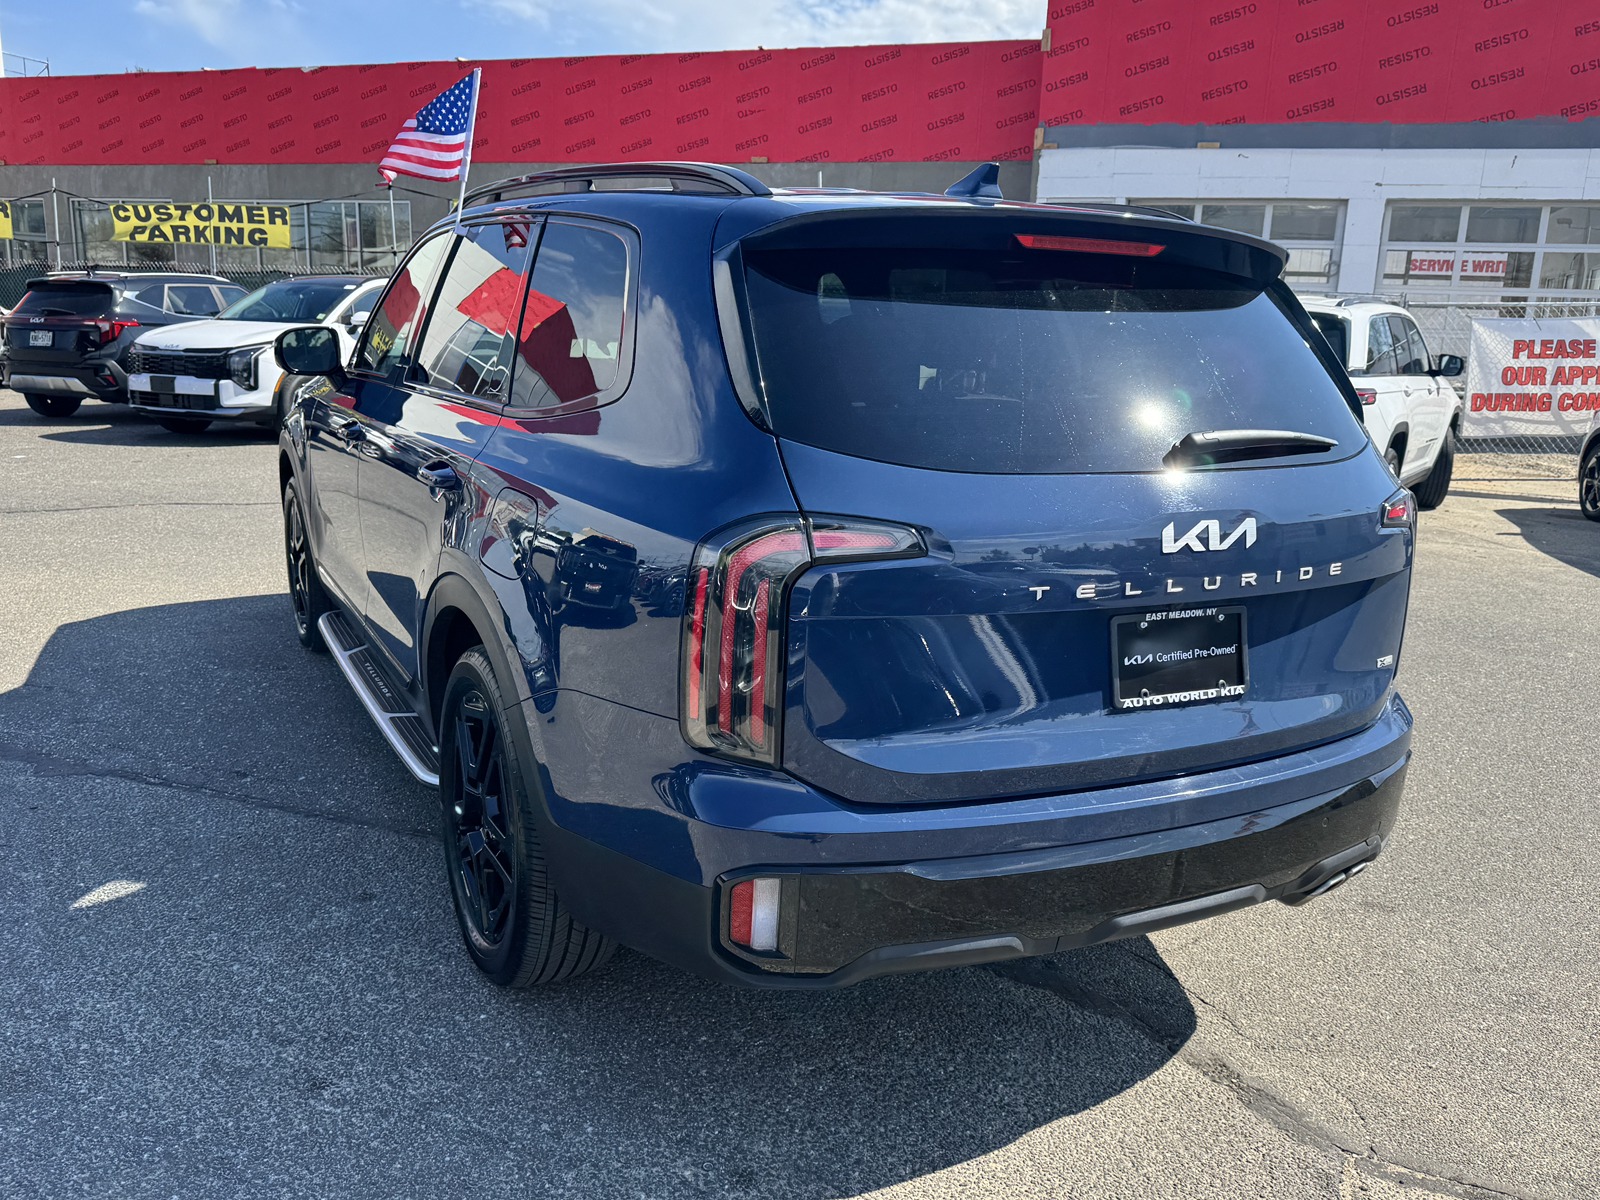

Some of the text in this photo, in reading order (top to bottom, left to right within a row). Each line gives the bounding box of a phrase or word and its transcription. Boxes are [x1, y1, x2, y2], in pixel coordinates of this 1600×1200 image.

[1051, 0, 1095, 20] RESISTO
[1209, 3, 1257, 26] RESISTO
[1386, 3, 1439, 27] RESISTO
[1126, 21, 1171, 43] RESISTO
[1295, 19, 1345, 44] RESISTO
[1474, 29, 1529, 53] RESISTO
[1047, 37, 1090, 58] RESISTO
[1207, 39, 1255, 63] RESISTO
[1125, 55, 1170, 78] RESISTO
[1378, 46, 1431, 70] RESISTO
[1045, 71, 1089, 93] RESISTO
[1288, 61, 1338, 85] RESISTO
[1470, 66, 1525, 91] RESISTO
[222, 87, 247, 101] RESISTO
[313, 86, 340, 101] RESISTO
[360, 84, 388, 100] RESISTO
[409, 83, 437, 99] RESISTO
[511, 81, 542, 97] RESISTO
[565, 79, 596, 96] RESISTO
[621, 77, 653, 95] RESISTO
[678, 76, 712, 93] RESISTO
[861, 83, 898, 103] RESISTO
[927, 81, 966, 100] RESISTO
[997, 79, 1037, 99] RESISTO
[1201, 79, 1249, 102] RESISTO
[137, 89, 161, 103] RESISTO
[179, 87, 203, 102] RESISTO
[267, 87, 293, 102] RESISTO
[735, 86, 771, 104] RESISTO
[797, 86, 833, 105] RESISTO
[1375, 83, 1428, 107] RESISTO
[1119, 95, 1165, 117] RESISTO
[1286, 97, 1335, 120] RESISTO
[139, 114, 162, 129] RESISTO
[180, 113, 204, 129] RESISTO
[224, 113, 248, 129] RESISTO
[268, 115, 293, 130] RESISTO
[313, 114, 340, 129] RESISTO
[361, 113, 387, 129] RESISTO
[510, 110, 541, 127] RESISTO
[564, 110, 595, 127] RESISTO
[619, 109, 652, 126] RESISTO
[676, 107, 710, 125] RESISTO
[797, 116, 833, 135] RESISTO
[861, 114, 898, 133] RESISTO
[927, 112, 965, 132] RESISTO
[995, 110, 1036, 130] RESISTO
[183, 139, 207, 153] RESISTO
[227, 139, 251, 152] RESISTO
[271, 139, 296, 155] RESISTO
[315, 140, 342, 155] RESISTO
[511, 138, 541, 155] RESISTO
[565, 137, 596, 155] RESISTO
[620, 137, 653, 155] RESISTO
[677, 137, 710, 154] RESISTO
[735, 134, 769, 152] RESISTO
[112, 203, 288, 225] CUSTOMER
[129, 225, 268, 247] PARKING
[1512, 339, 1597, 359] PLEASE
[1501, 366, 1547, 386] OUR
[1470, 393, 1553, 412] DURING
[1161, 517, 1257, 554] KIA
[1028, 561, 1343, 601] TELLURIDE
[1145, 612, 1167, 621] EAST
[1206, 607, 1218, 616] NY
[1124, 644, 1236, 666] KIA Certified Pre-Owned
[364, 662, 393, 699] TELLURIDE
[1122, 685, 1246, 709] AUTO WORLD KIA
